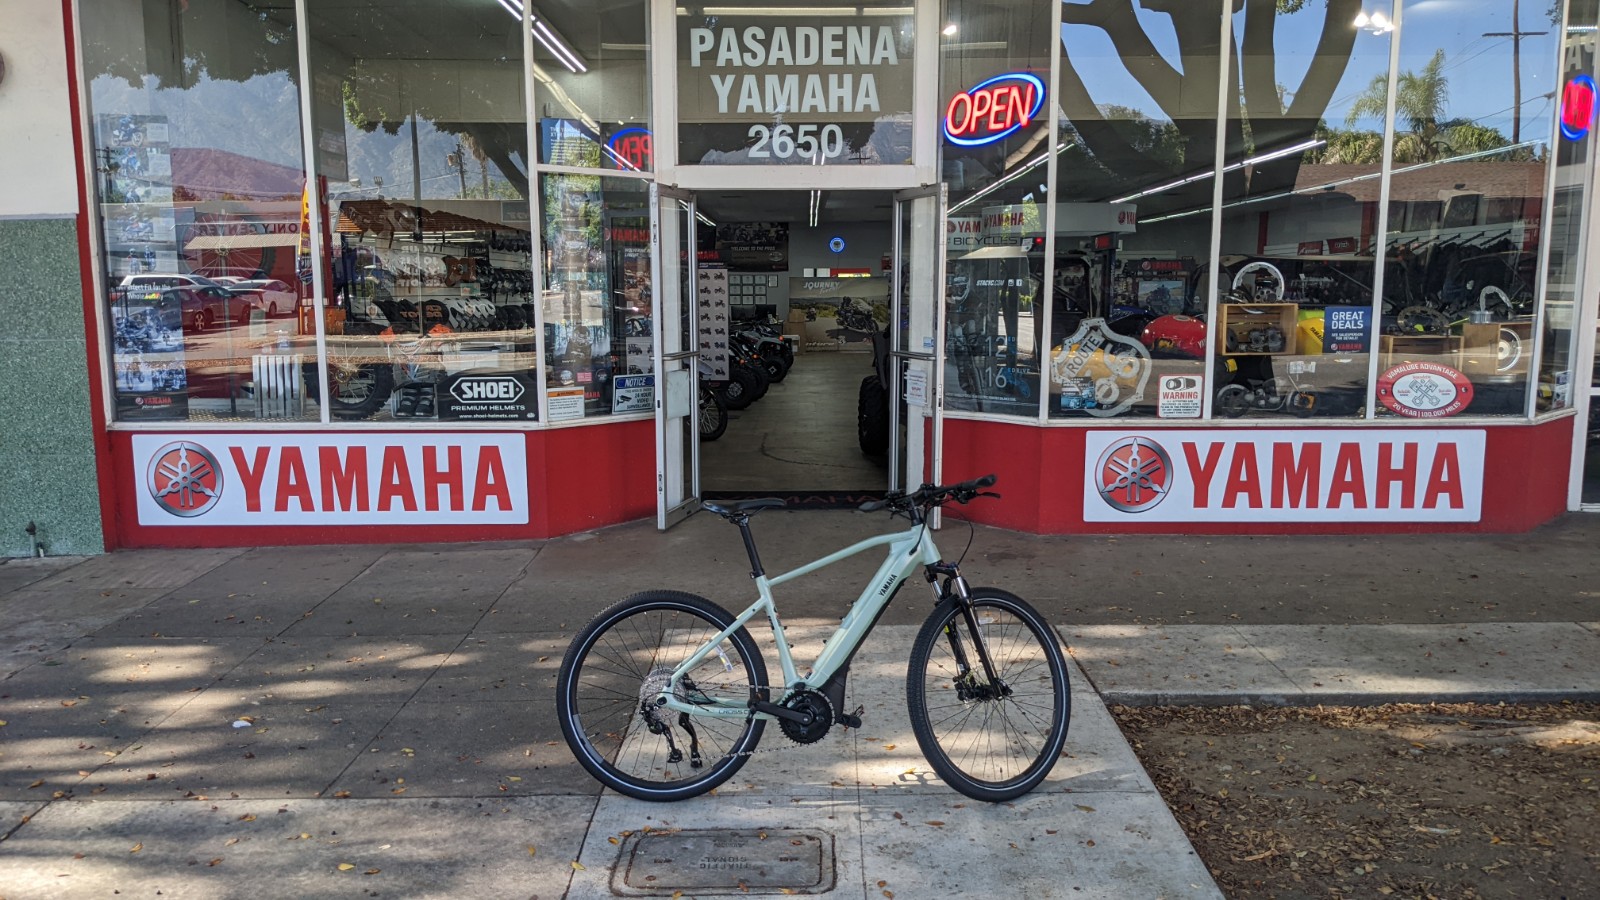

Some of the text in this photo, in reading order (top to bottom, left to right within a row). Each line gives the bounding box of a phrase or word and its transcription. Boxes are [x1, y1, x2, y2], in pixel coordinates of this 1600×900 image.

[690, 26, 898, 67] PASADENA
[710, 73, 880, 113] YAMAHA
[946, 82, 1034, 136] OPEN
[748, 124, 843, 158] 2650
[957, 220, 981, 233] YAM
[989, 212, 1024, 227] YAMAHA
[953, 236, 1018, 246] BICYCLES
[803, 281, 840, 290] JOURNEY
[1332, 311, 1364, 320] GREAT
[1331, 320, 1364, 330] DEALS
[985, 335, 1007, 358] 12
[1066, 335, 1100, 374] ROUTE
[985, 366, 1007, 389] 16
[1386, 363, 1458, 379] YAMALUBE ADVANTAGE
[461, 381, 514, 399] SHOEI
[625, 378, 647, 387] NOTICE
[1162, 391, 1199, 400] WARNING
[1392, 402, 1402, 411] 20
[1401, 407, 1418, 416] YEAR
[1445, 400, 1462, 413] MILES
[228, 445, 513, 512] YAMAHA
[1181, 442, 1464, 509] YAMAHA
[878, 573, 898, 597] YAMAHA
